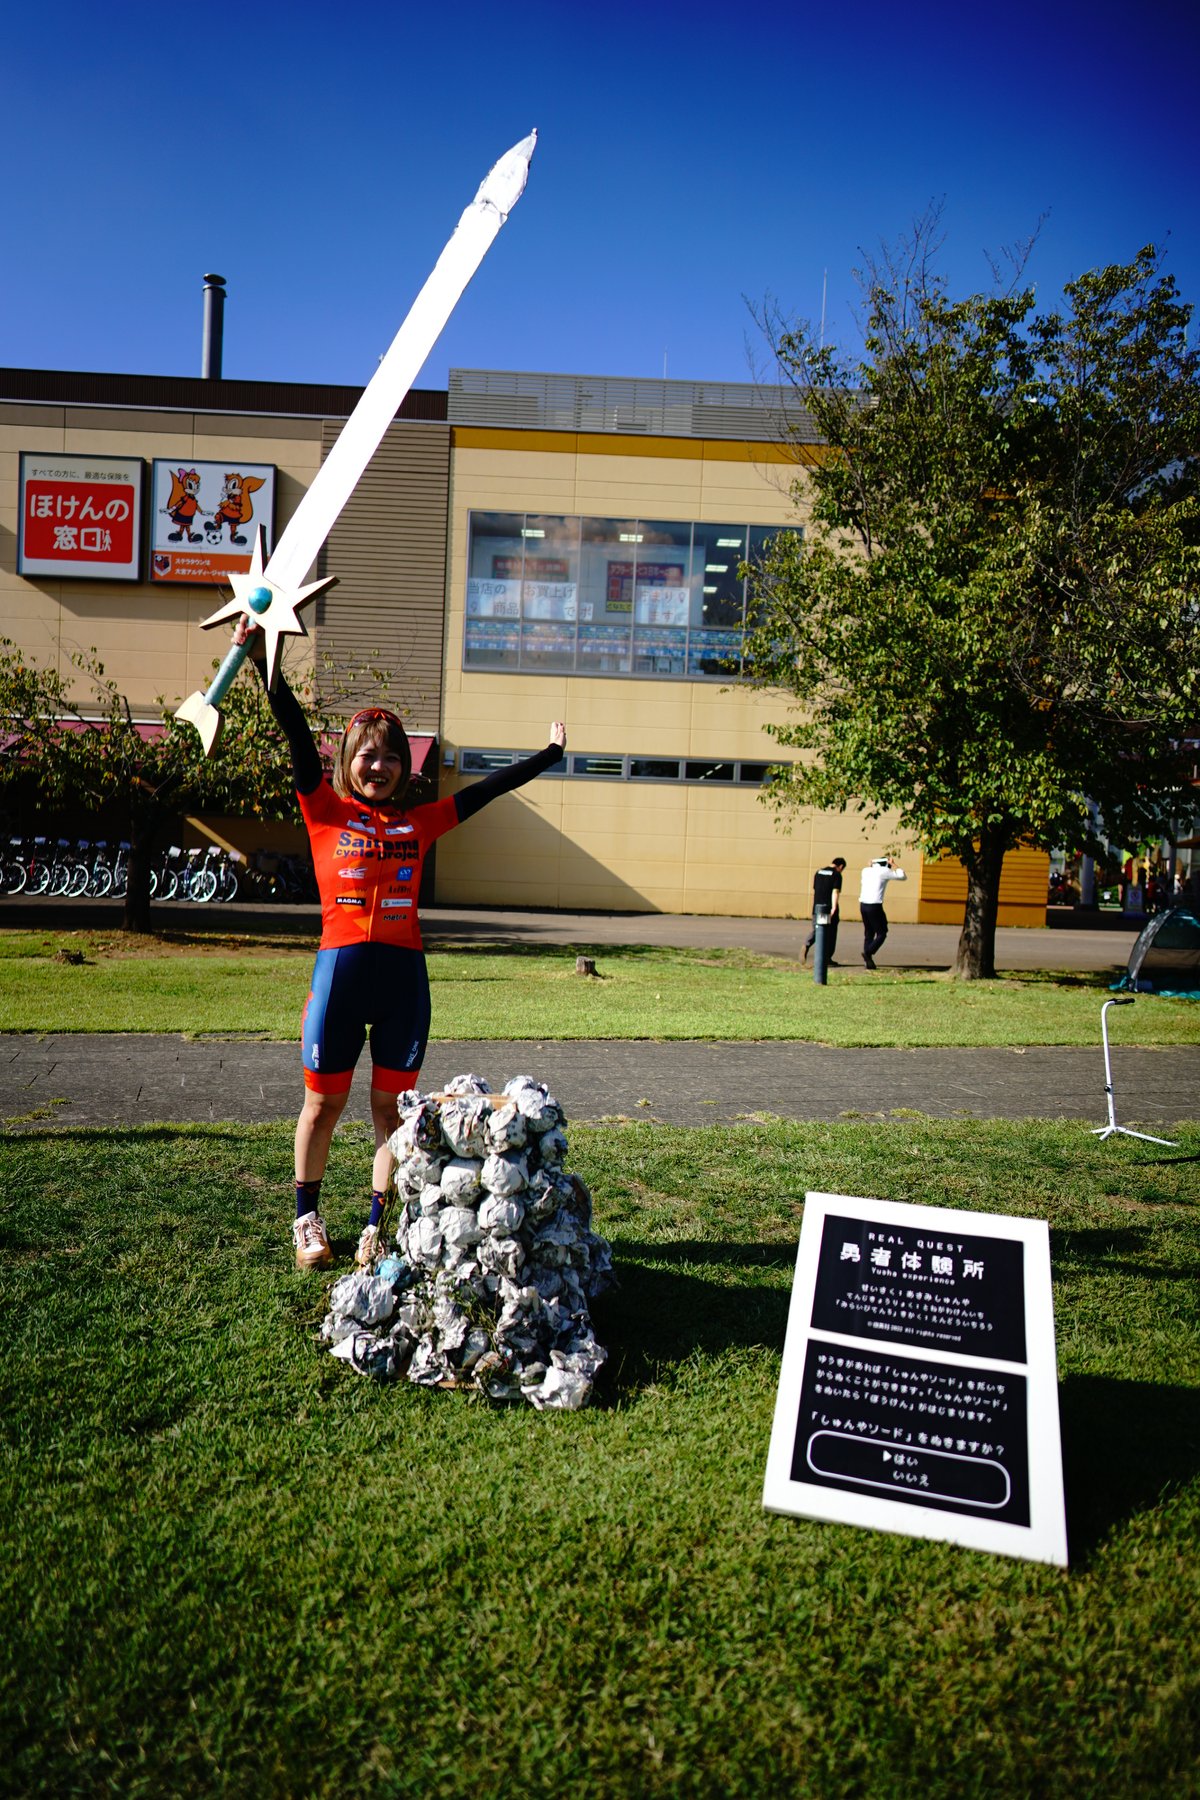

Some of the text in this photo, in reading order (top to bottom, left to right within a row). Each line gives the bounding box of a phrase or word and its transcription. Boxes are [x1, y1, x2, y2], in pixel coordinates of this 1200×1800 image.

[30, 494, 129, 522] ほけんの
[53, 525, 101, 552] 窓口
[494, 601, 519, 615] 商品
[868, 1232, 965, 1253] REAL QUEST
[839, 1242, 985, 1281] 勇者体験所
[871, 1266, 956, 1286] Yusha experience
[893, 1453, 918, 1466] はい
[893, 1470, 930, 1487] いいえ
